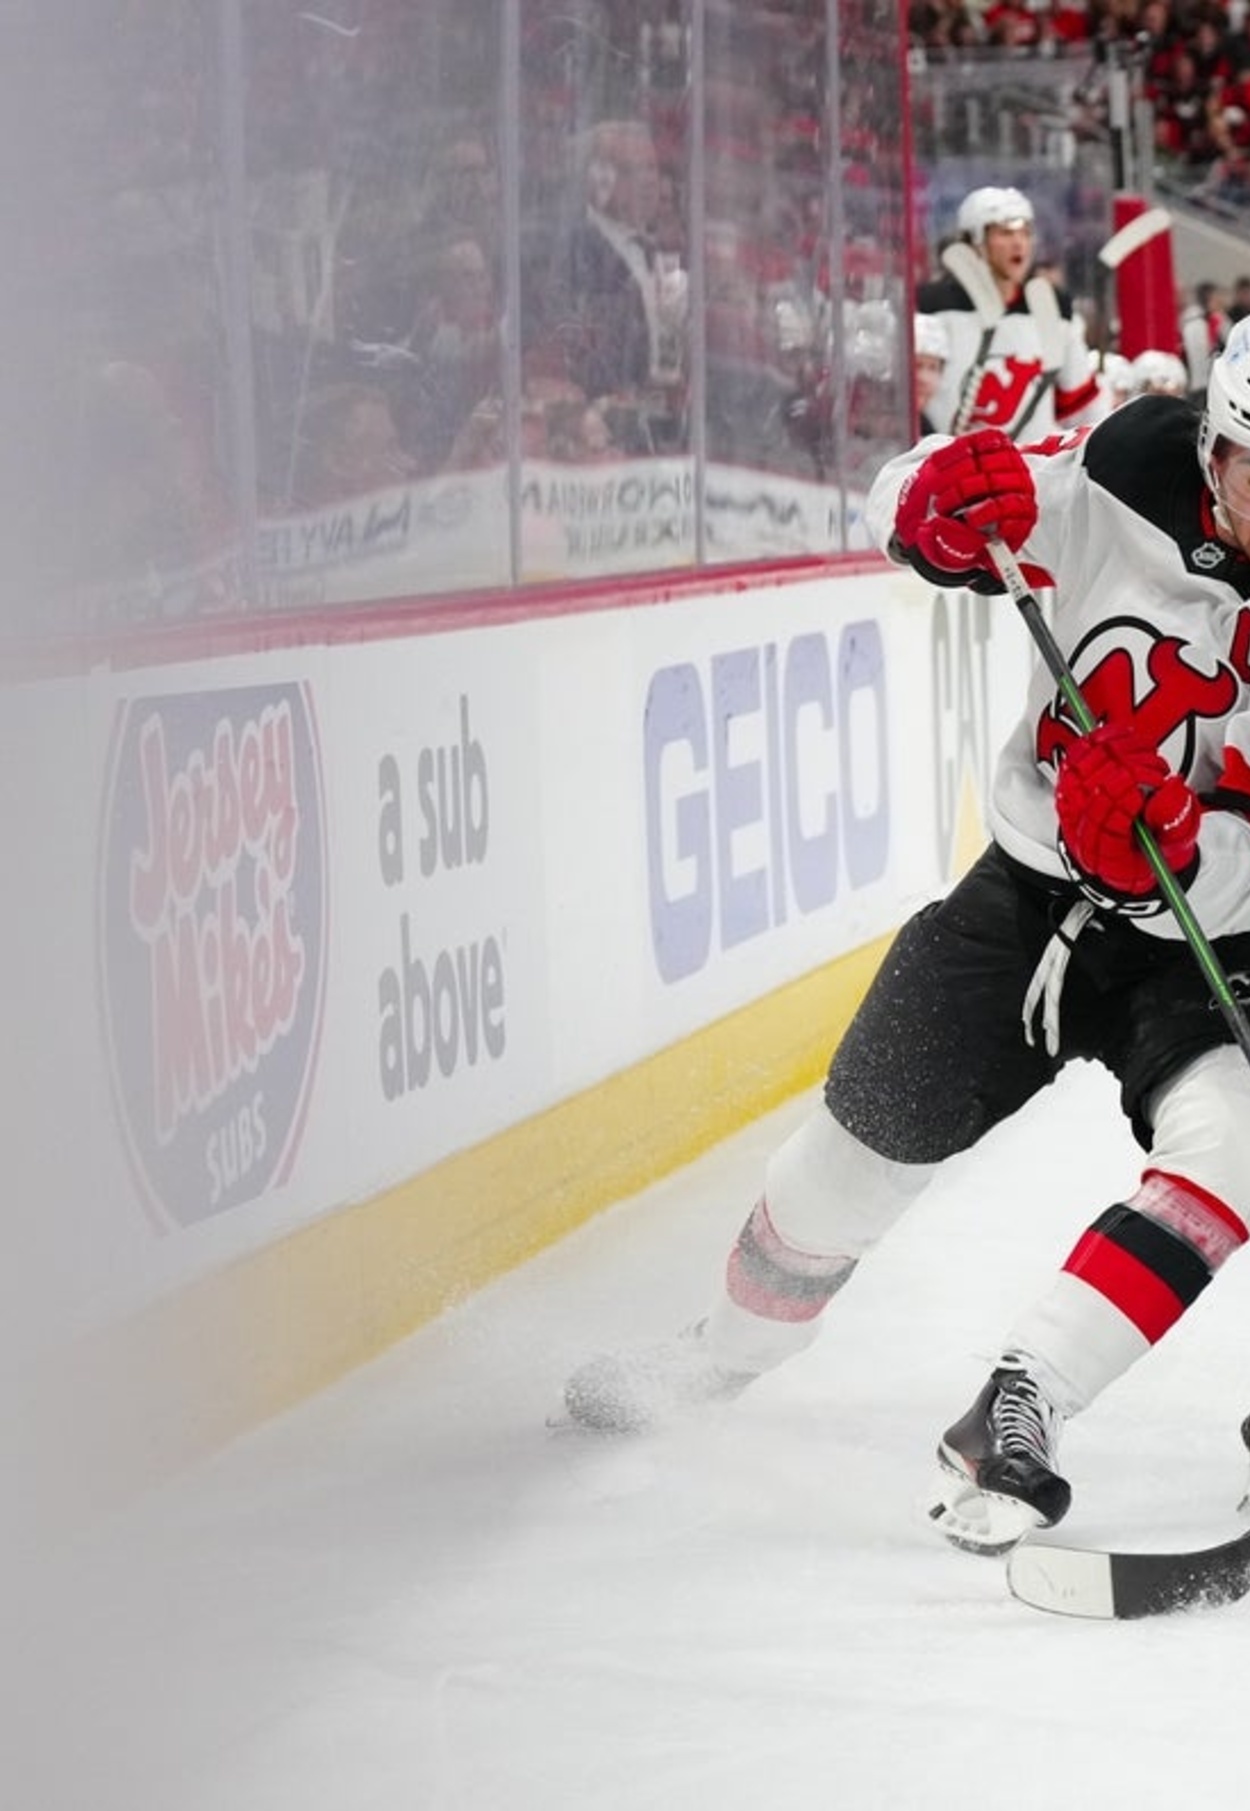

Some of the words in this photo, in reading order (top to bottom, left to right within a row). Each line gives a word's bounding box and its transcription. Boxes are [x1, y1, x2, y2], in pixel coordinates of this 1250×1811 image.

[131, 700, 299, 938] Jersey
[378, 754, 404, 888] a
[418, 694, 490, 878] sub
[643, 618, 891, 986] GEICO
[378, 912, 506, 1102] above
[207, 1094, 267, 1201] SUBS
